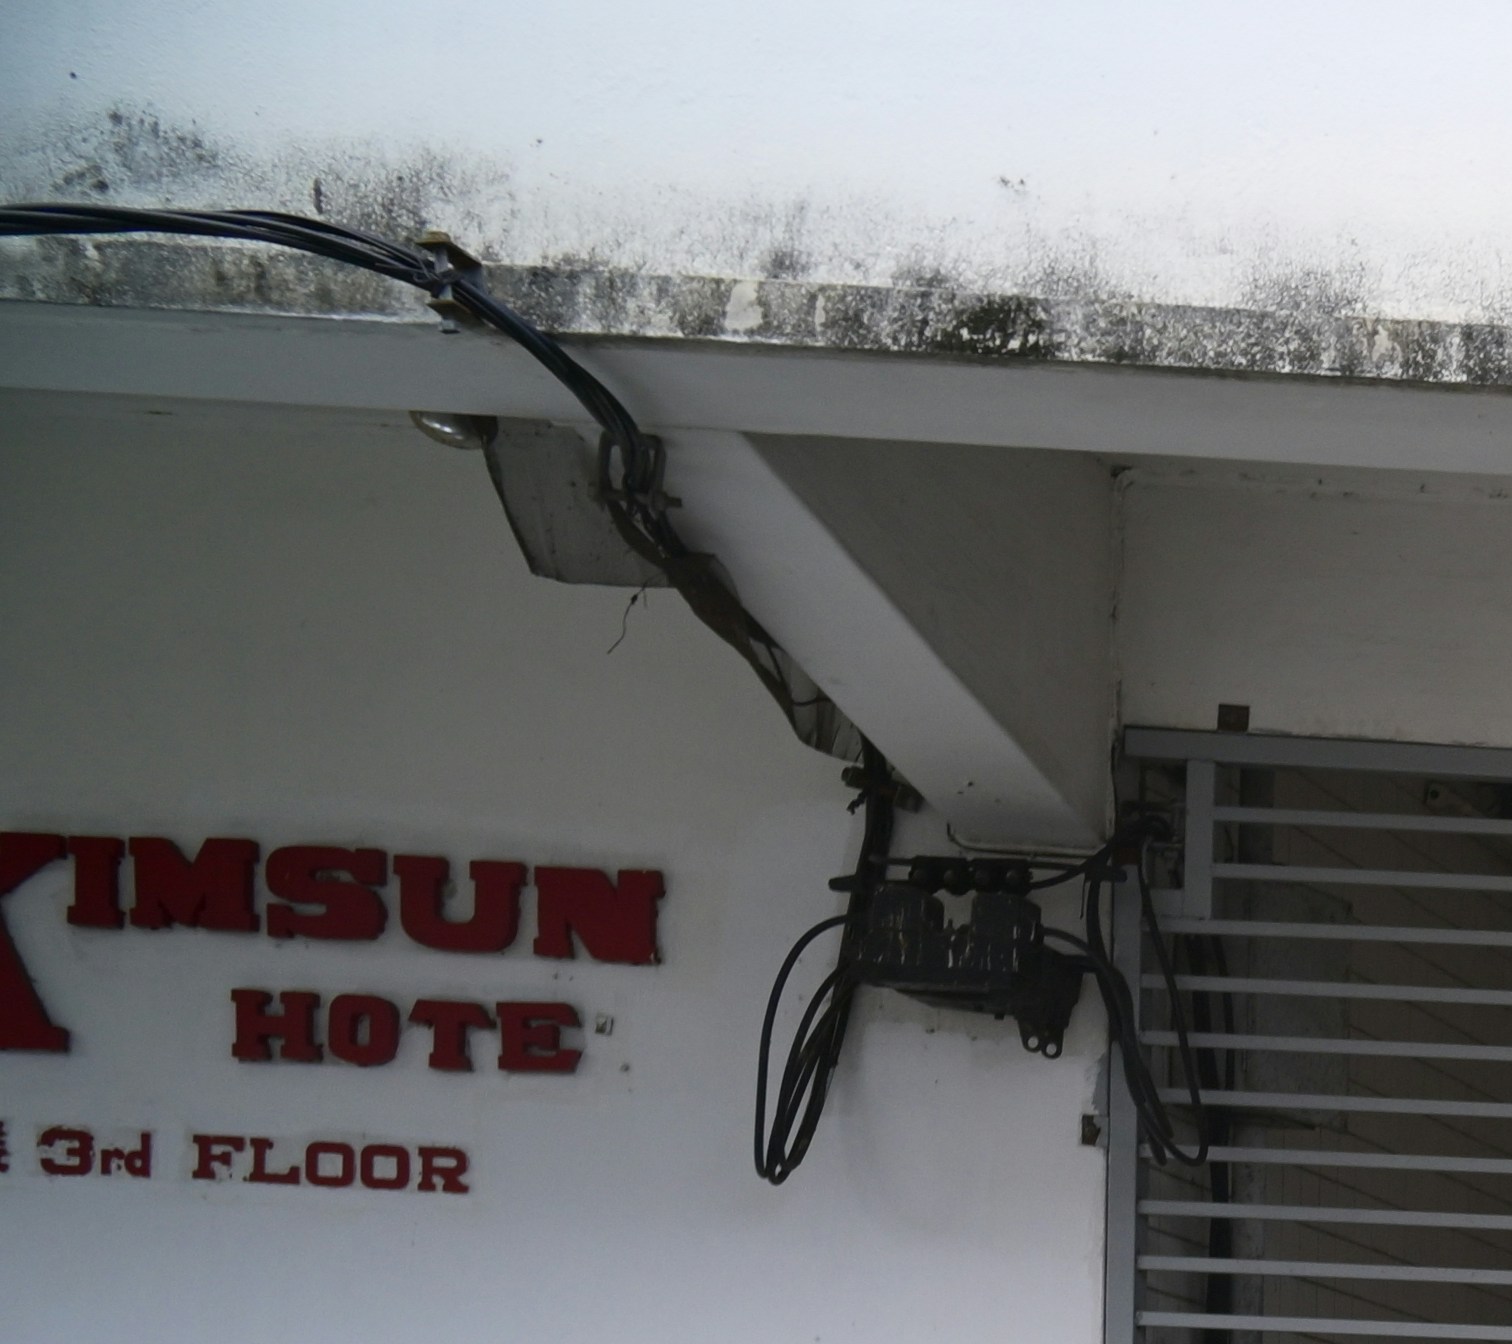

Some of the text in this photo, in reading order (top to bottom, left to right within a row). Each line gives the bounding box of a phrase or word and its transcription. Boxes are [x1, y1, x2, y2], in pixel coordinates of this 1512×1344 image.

[232, 988, 585, 1074] HOTE
[37, 1126, 470, 1195] 3rd FLOOR
